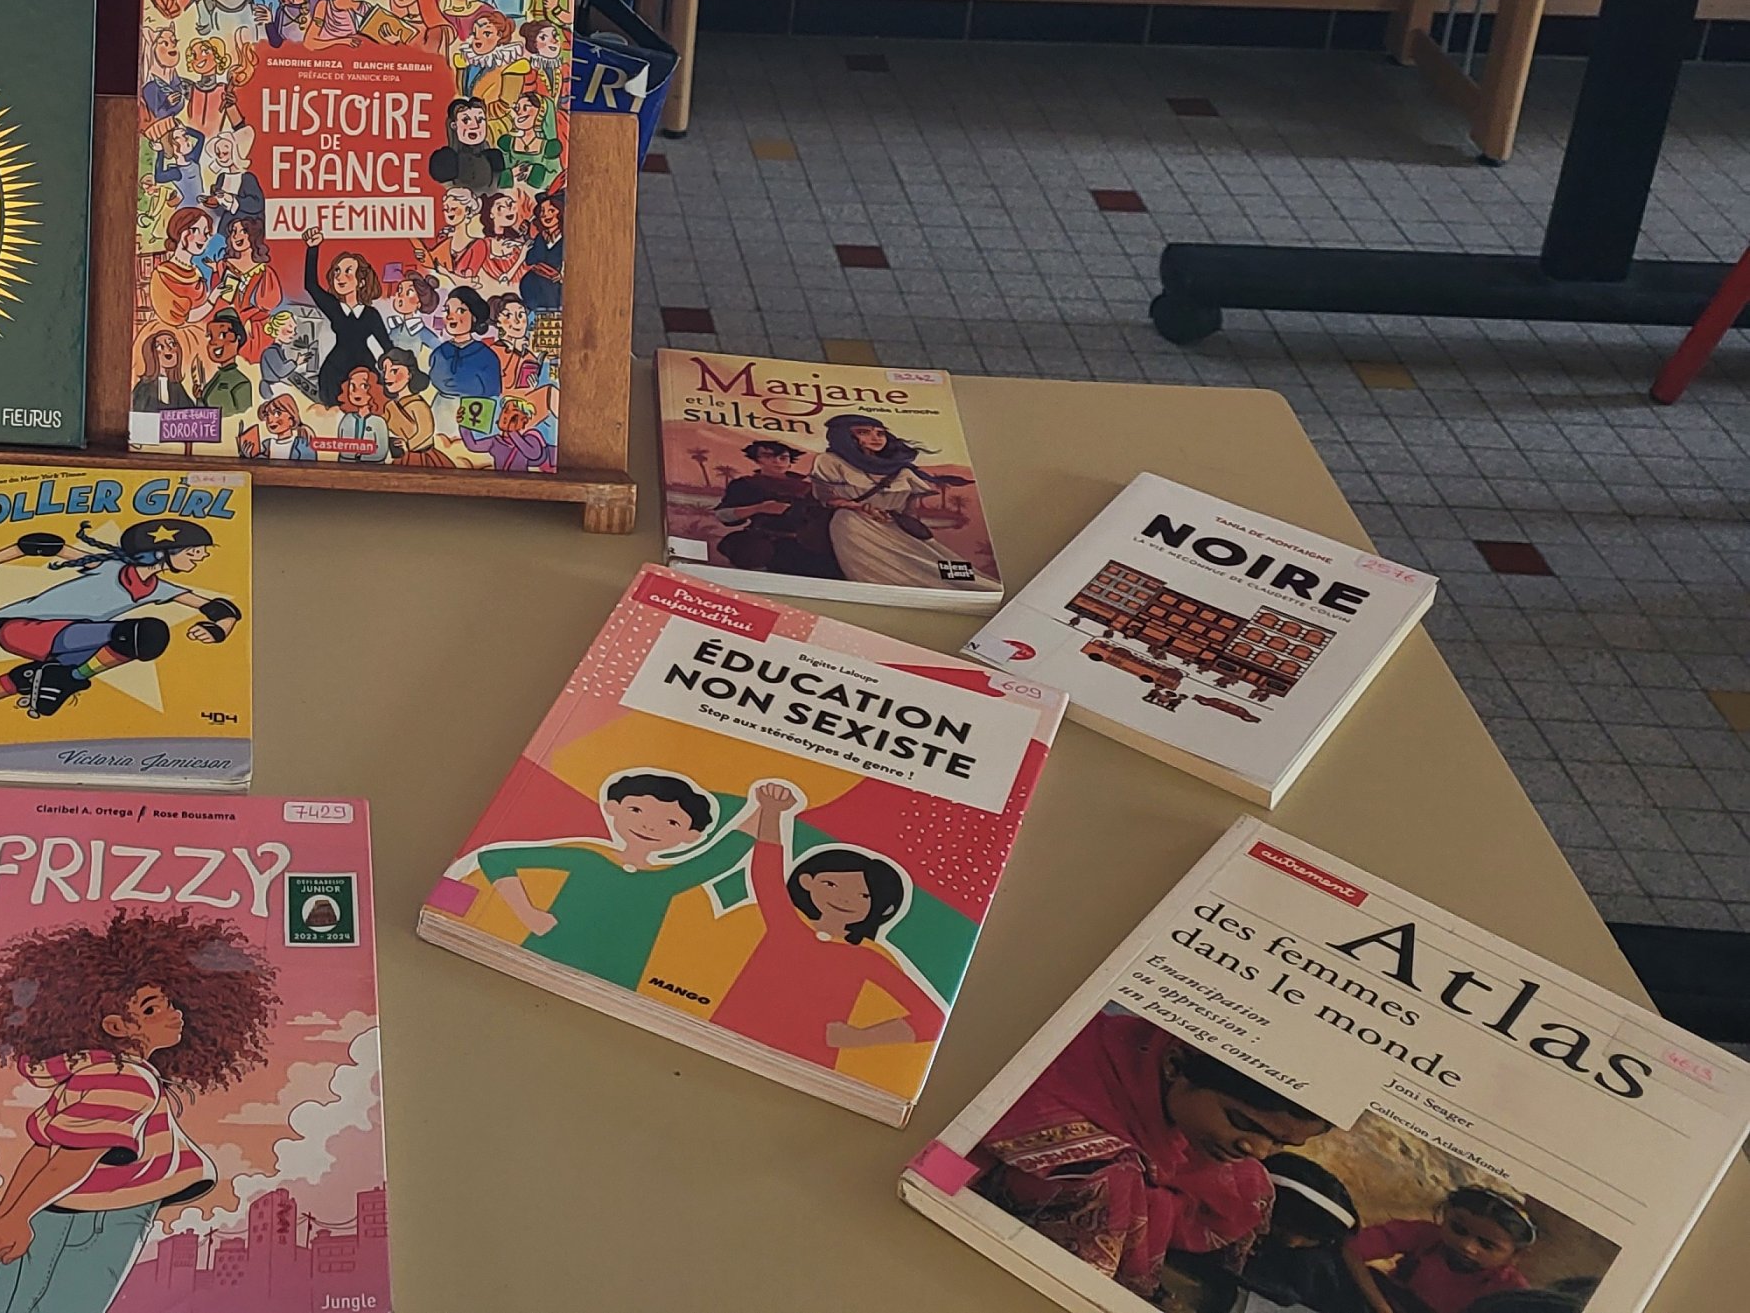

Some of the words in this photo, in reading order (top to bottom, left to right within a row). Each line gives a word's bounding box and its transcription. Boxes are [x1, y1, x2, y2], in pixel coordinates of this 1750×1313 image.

[267, 59, 312, 67] SANDRINE
[314, 60, 343, 69] MIRZA
[298, 71, 332, 80] PRÉFACE
[353, 61, 394, 70] BLANCHE
[397, 63, 432, 71] SABBAH
[320, 134, 341, 150] DE
[272, 146, 422, 193] FRANCE
[272, 206, 307, 232] AU
[685, 396, 704, 406] et
[707, 395, 725, 407] le
[690, 357, 909, 416] Marjane
[2, 408, 62, 428] FLEURUS
[162, 420, 217, 438] SORORITÉ
[682, 402, 814, 434] sultan
[313, 441, 374, 451] casterman
[132, 476, 236, 519] GIRL
[1140, 514, 1370, 616] NOIRE
[673, 588, 741, 617] Parents
[798, 654, 837, 672] Brigitte
[839, 665, 879, 686] Laloupe
[693, 639, 972, 745] ÉDUCATION
[201, 711, 238, 723] 404
[663, 663, 779, 714] NON
[783, 702, 977, 780] SEXISTE
[698, 704, 730, 724] Stop
[733, 716, 757, 730] aux
[759, 724, 840, 759] stéréotypes
[842, 752, 860, 764] de
[862, 759, 905, 779] genre
[907, 771, 915, 780] !
[58, 751, 134, 767] Victoria
[141, 753, 232, 771] Jamieson
[36, 805, 79, 814] Claribel
[82, 807, 92, 815] A.
[95, 808, 133, 818] Ortega
[153, 810, 179, 819] Rose
[181, 810, 236, 821] Bousamra
[291, 806, 346, 819] 7429
[1260, 850, 1356, 898] autrement
[301, 885, 340, 893] JUNIOR
[1194, 902, 1256, 942] des
[1264, 936, 1420, 1027] femmes
[648, 977, 711, 1006] MANGO
[1145, 955, 1272, 1027] Émancipation
[1170, 927, 1260, 982] dans
[1267, 974, 1306, 1007] le
[1314, 1005, 1462, 1088] monde
[1325, 921, 1653, 1101] Atlas
[1119, 985, 1145, 1001] un
[1141, 999, 1219, 1044] paysage
[1221, 1041, 1309, 1091] contrasté
[1384, 1079, 1421, 1101] Joni
[1423, 1097, 1475, 1129] Seager
[1369, 1100, 1429, 1138] Collection
[1432, 1136, 1511, 1179] Atlas/Monde
[321, 1293, 377, 1311] Jungle
